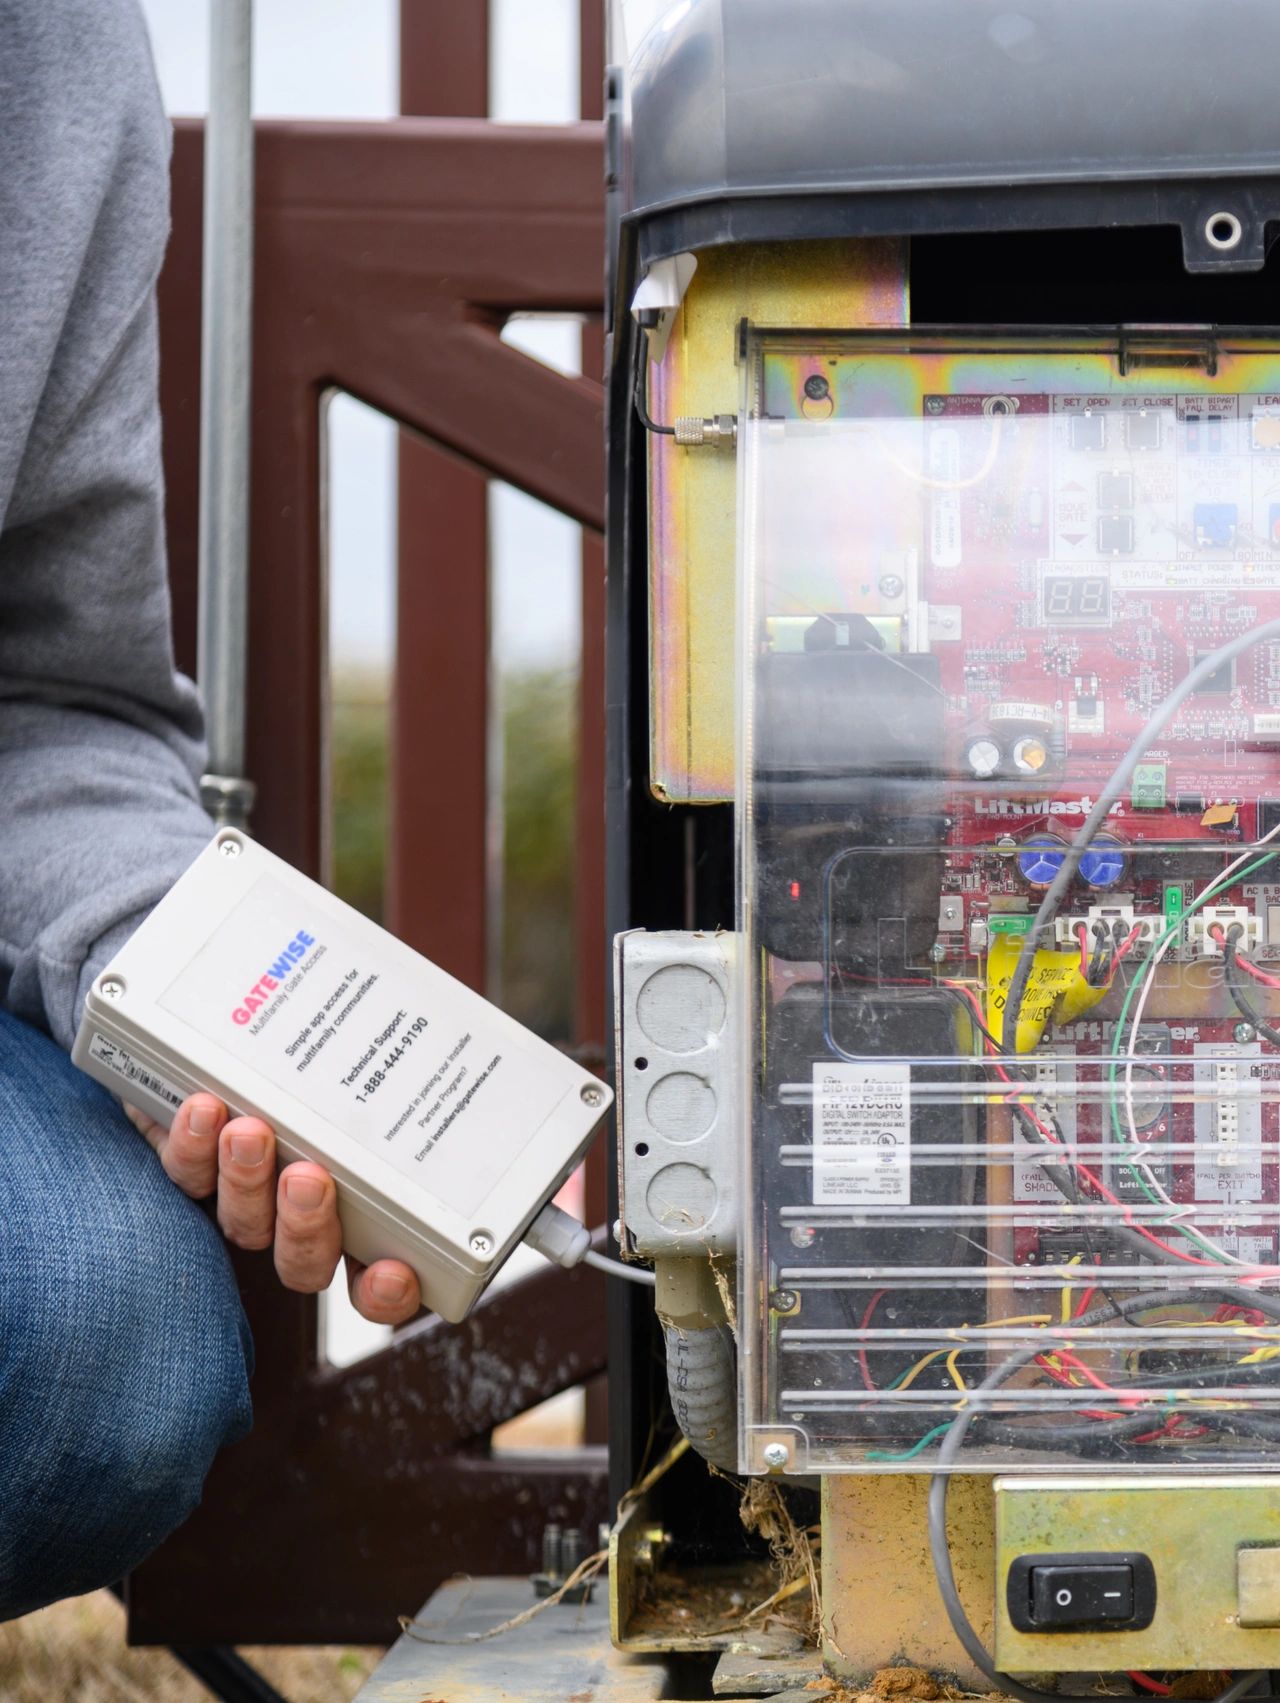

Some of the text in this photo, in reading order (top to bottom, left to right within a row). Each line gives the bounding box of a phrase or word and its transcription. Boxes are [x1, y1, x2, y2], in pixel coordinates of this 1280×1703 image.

[1087, 397, 1111, 407] OPEN
[1143, 397, 1174, 407] CLOSE
[1058, 503, 1088, 512] MOVE
[1058, 513, 1088, 523] GATE
[1178, 551, 1197, 561] OFF
[1252, 551, 1273, 561] MIN
[1121, 570, 1164, 580] STATUS:
[974, 796, 1122, 815] LiftMastr
[1184, 882, 1193, 906] FUSE
[1246, 886, 1258, 895] AC
[231, 929, 316, 1026] GATEWISE
[248, 944, 327, 1036] Multifamily Gate Access
[284, 968, 359, 1057] Simple app access for
[294, 971, 379, 1072] multifamily communities.
[1052, 1021, 1199, 1041] Lifter
[340, 1008, 408, 1087] Technical Support:
[354, 1016, 429, 1104] 1-888-444-9190
[383, 1032, 472, 1141] Interested in joining our Installer
[417, 1066, 470, 1127] Partner Program?
[414, 1054, 503, 1161] Email installers@gatewise.com
[847, 1110, 873, 1120] SWITCH
[1158, 1123, 1166, 1132] 6
[1024, 1182, 1060, 1192] SHAD
[1217, 1180, 1244, 1190] EXIT
